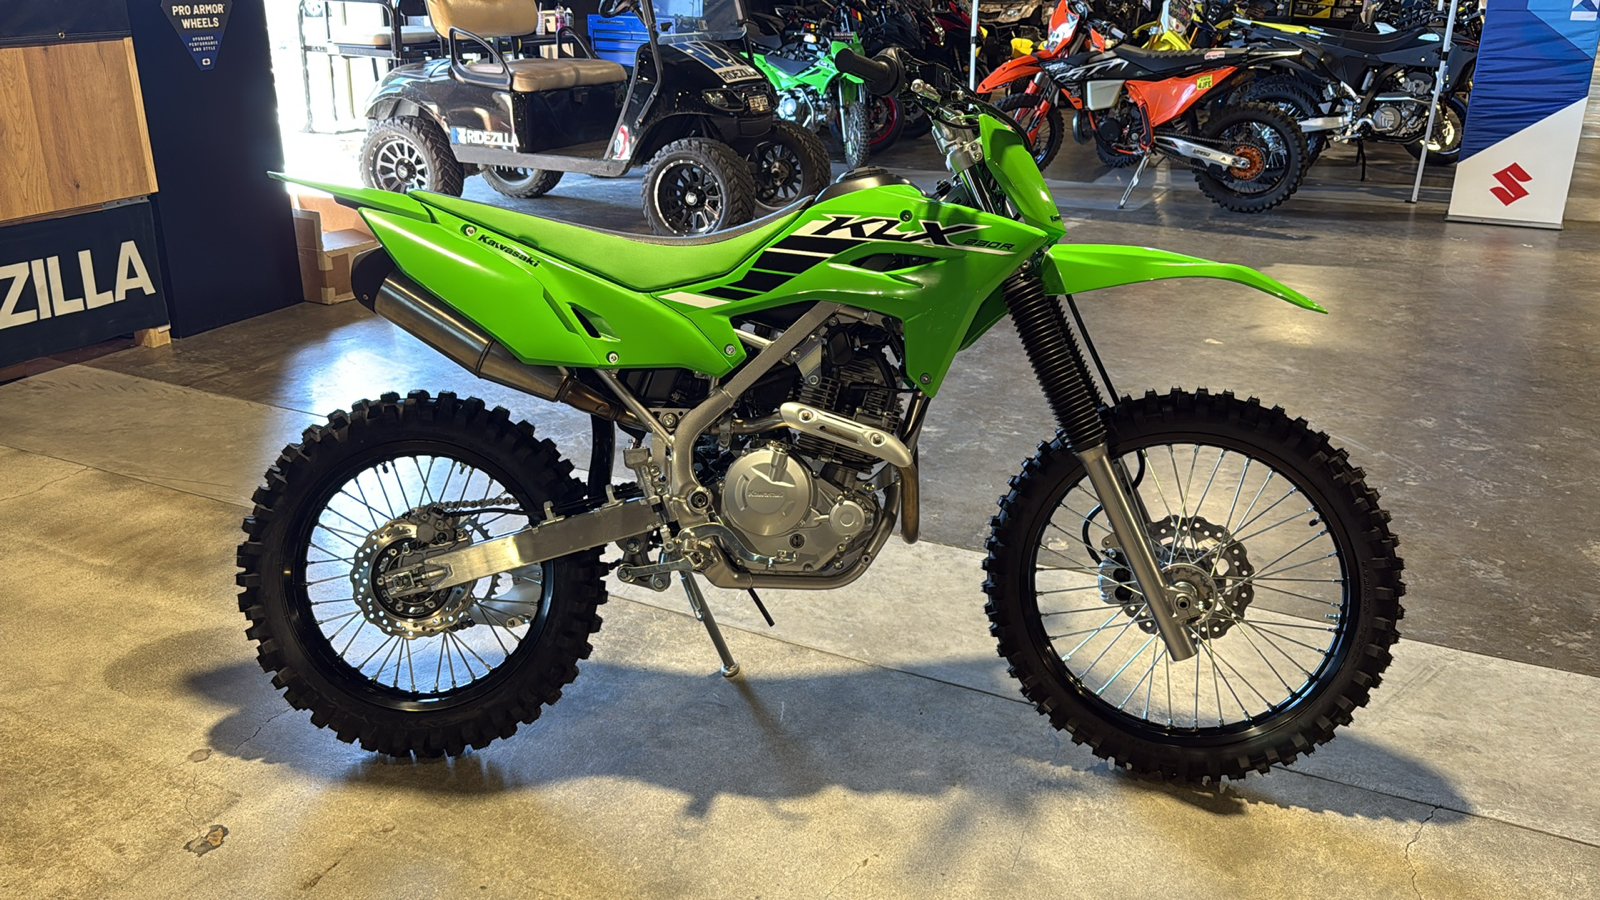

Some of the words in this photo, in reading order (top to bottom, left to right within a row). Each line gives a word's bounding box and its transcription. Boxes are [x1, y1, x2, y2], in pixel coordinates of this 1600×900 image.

[172, 5, 191, 16] PRO
[193, 4, 224, 15] ARMOR
[181, 17, 219, 29] WHEELS
[466, 129, 520, 147] RIDEZILLA
[811, 214, 990, 247] KLX
[963, 238, 1015, 250] 230R
[478, 234, 540, 267] Kawasaki
